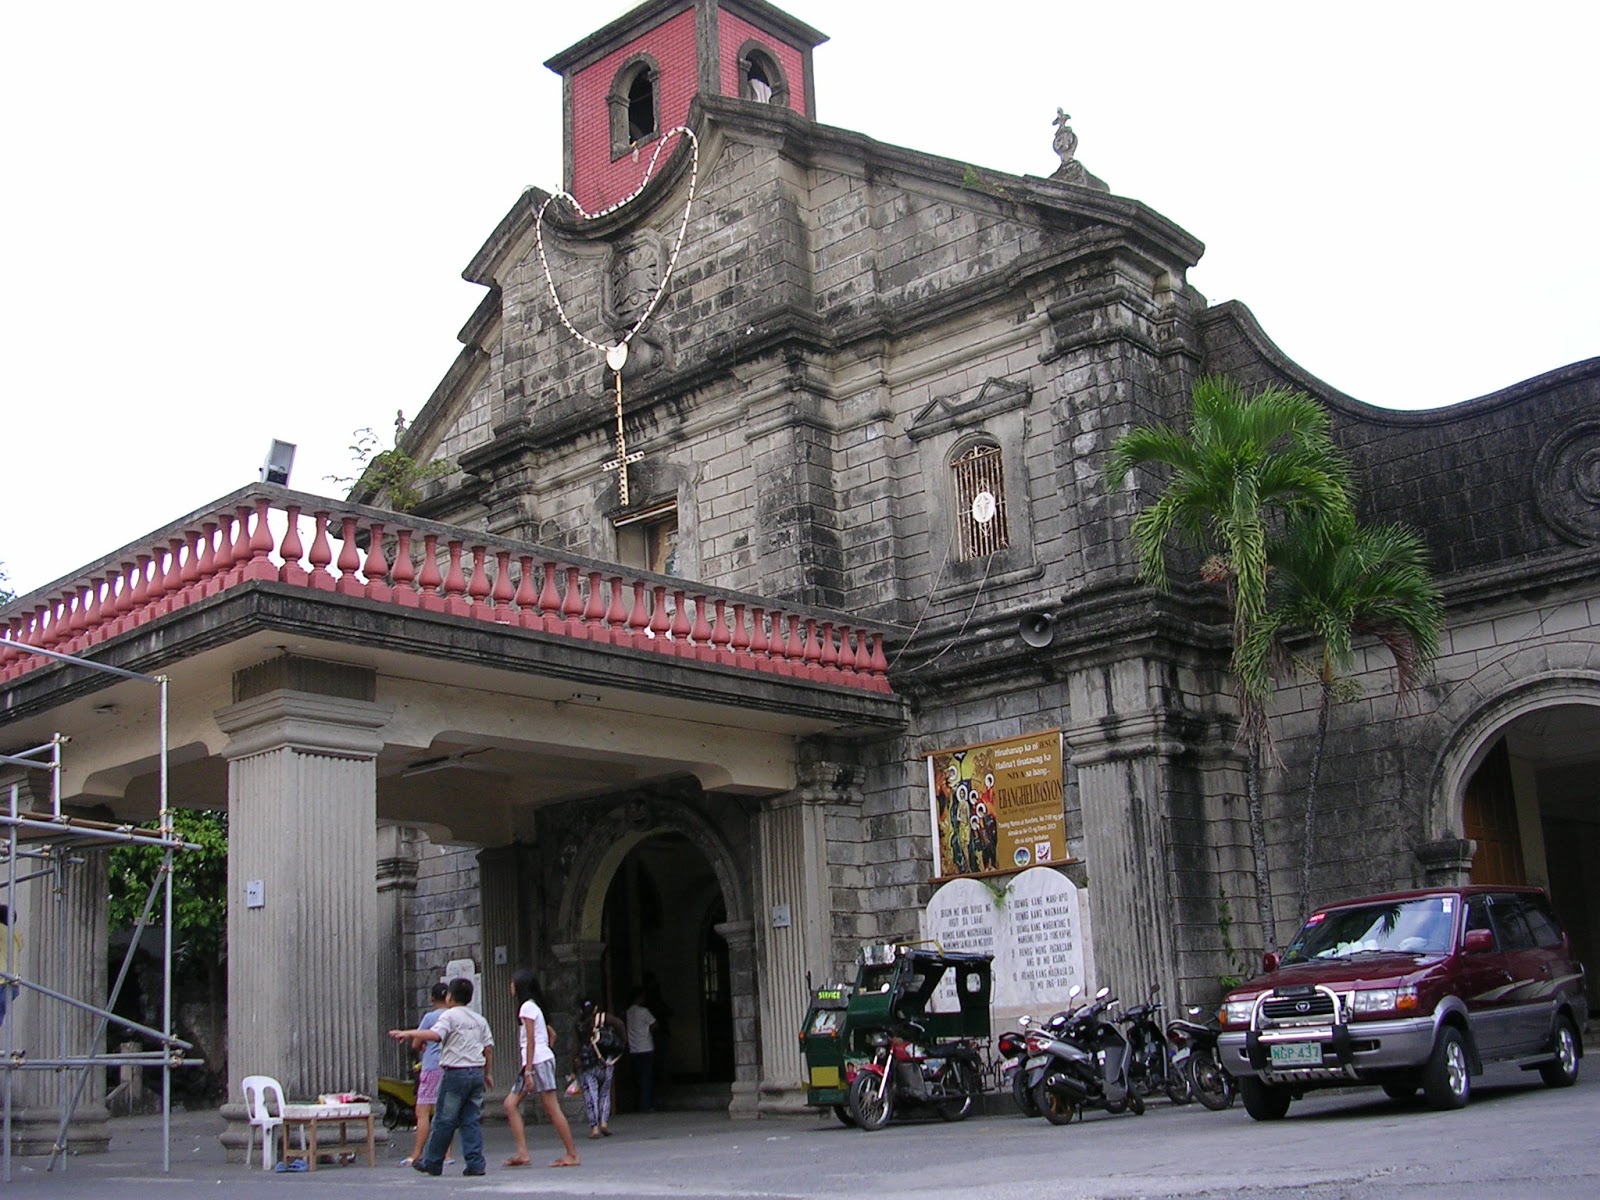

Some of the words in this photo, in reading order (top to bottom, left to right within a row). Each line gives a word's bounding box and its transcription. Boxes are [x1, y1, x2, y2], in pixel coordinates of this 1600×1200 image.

[995, 746, 1023, 758] Hinahanap
[999, 779, 1062, 809] EBANGHELISASYON
[818, 992, 840, 1000] SERVICE
[1298, 1046, 1319, 1058] 437
